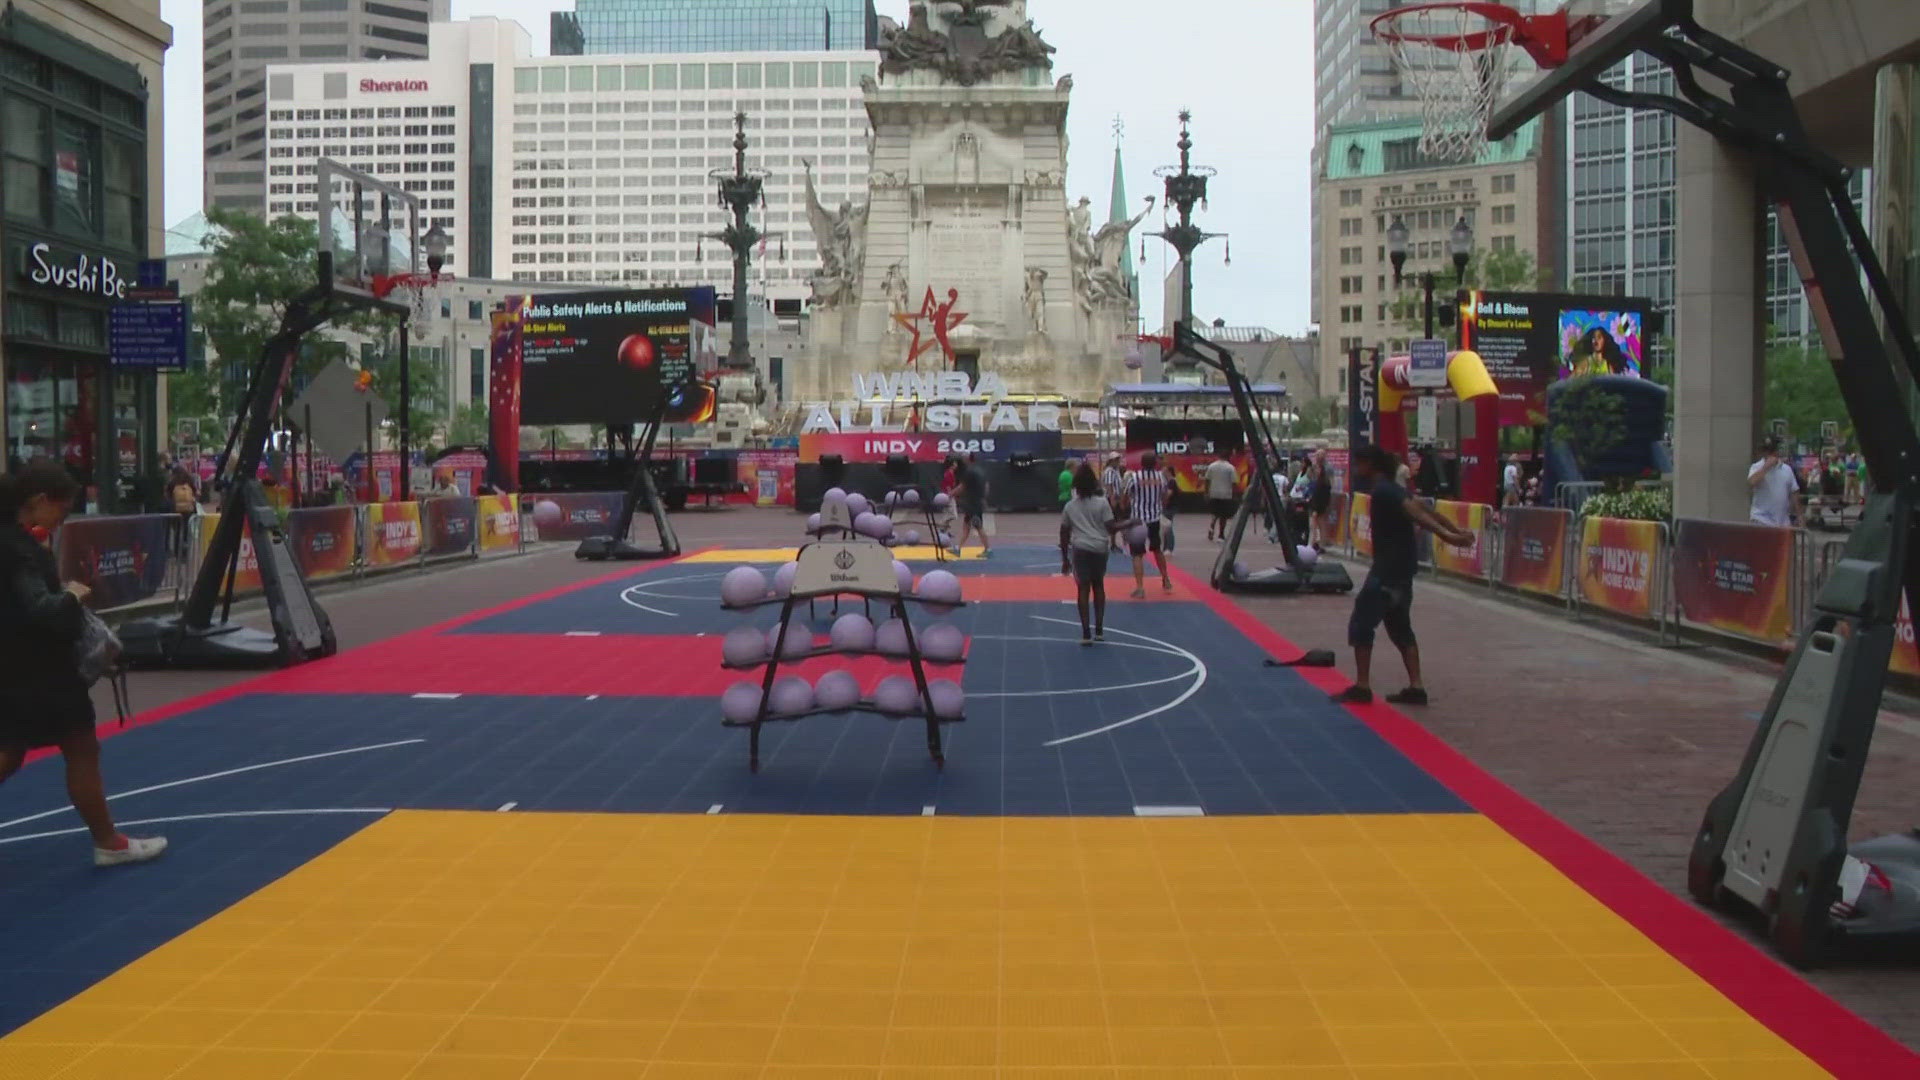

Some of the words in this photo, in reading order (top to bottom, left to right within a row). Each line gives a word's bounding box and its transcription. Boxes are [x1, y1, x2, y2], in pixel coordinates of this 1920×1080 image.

[359, 78, 429, 92] Sheraton
[32, 243, 98, 292] Sushi
[523, 304, 551, 318] Public
[553, 303, 583, 318] Safety
[585, 302, 613, 315] Alerts
[614, 301, 622, 314] &
[624, 299, 687, 313] Notifications
[1478, 303, 1493, 315] Ball
[1495, 303, 1502, 315] &
[852, 371, 1009, 400] WNBA
[801, 404, 904, 433] ALL
[925, 404, 1061, 432] STAR
[864, 440, 922, 454] INDY
[937, 439, 995, 453] 2025
[1602, 546, 1648, 577] INDY'S
[830, 573, 859, 583] Wilson
[1715, 568, 1728, 581] ALL
[1731, 571, 1753, 585] STAR
